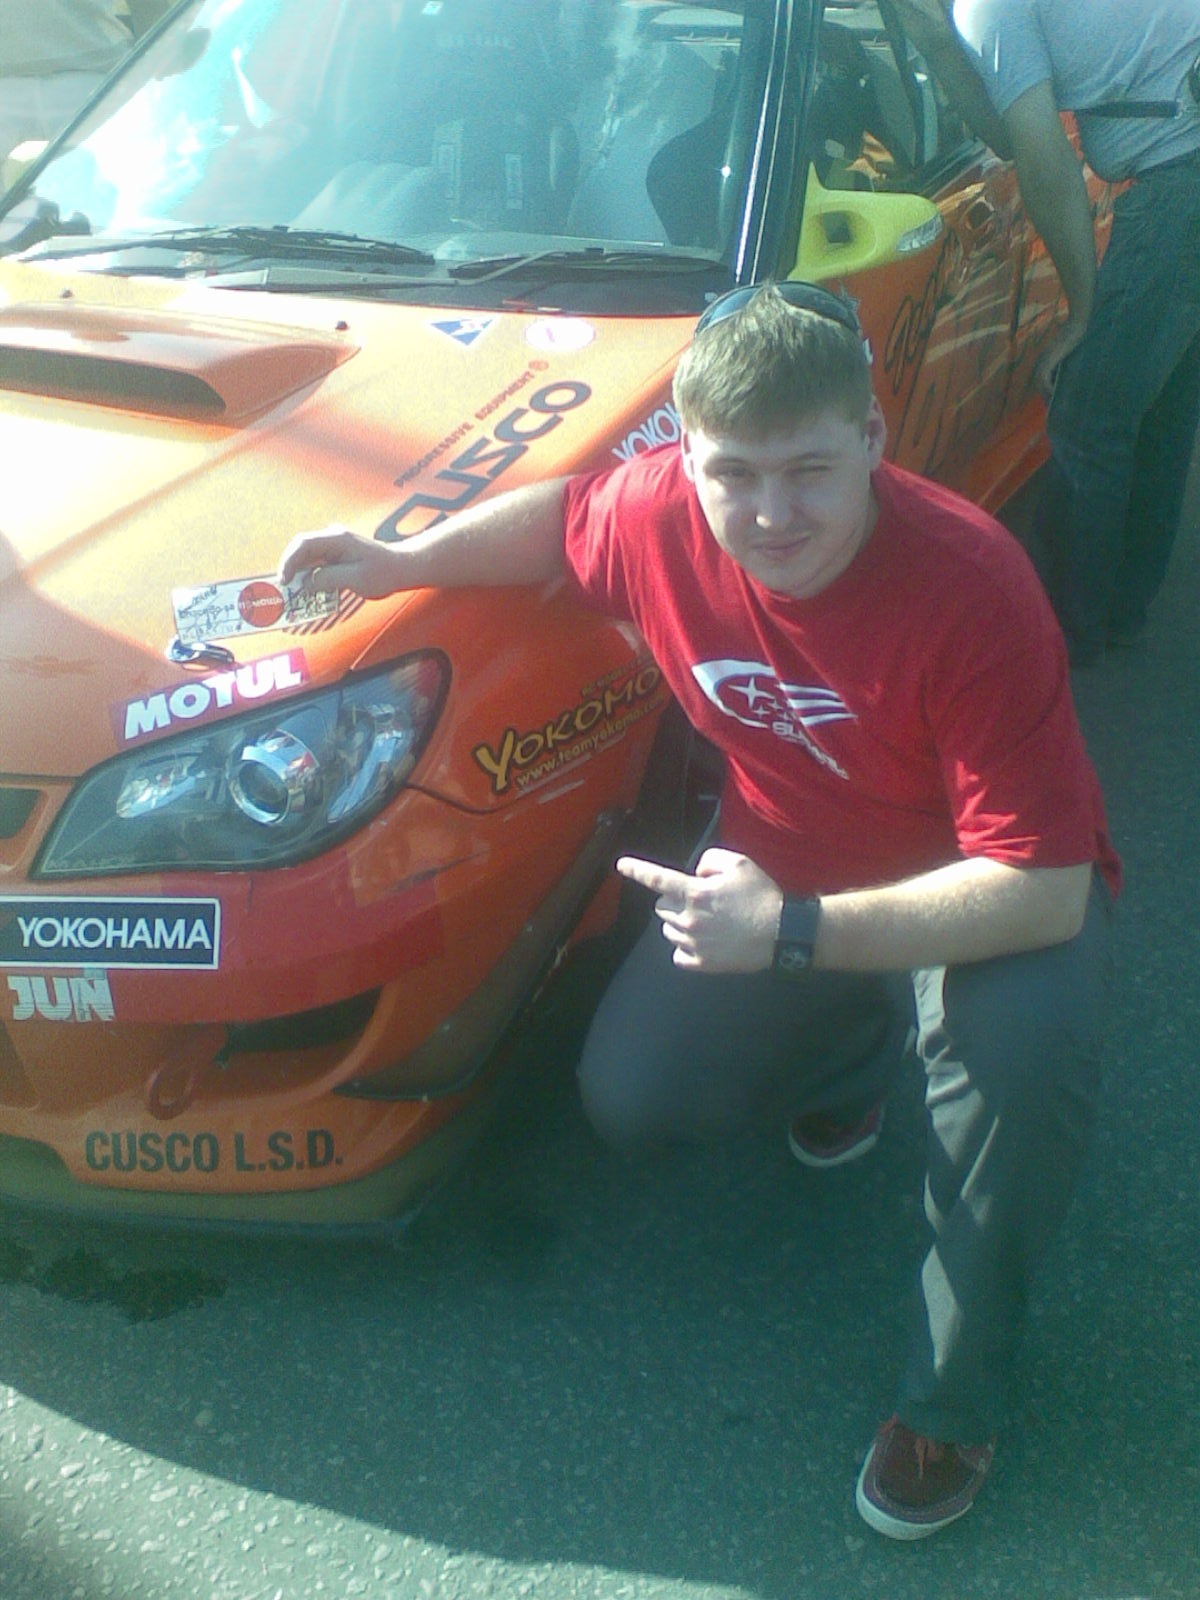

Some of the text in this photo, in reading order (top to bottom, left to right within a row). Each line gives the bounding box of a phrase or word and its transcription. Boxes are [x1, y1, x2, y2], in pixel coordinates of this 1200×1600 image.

[374, 381, 592, 543] CUSCO
[394, 371, 534, 488] PROGRESSIVE EQUIPMENT
[125, 655, 301, 739] MOTUL
[474, 666, 661, 792] YOKOMO
[17, 917, 212, 949] YOKOHAMA
[7, 975, 115, 1022] JUN
[85, 1128, 344, 1172] CUSCO L.S.D.
